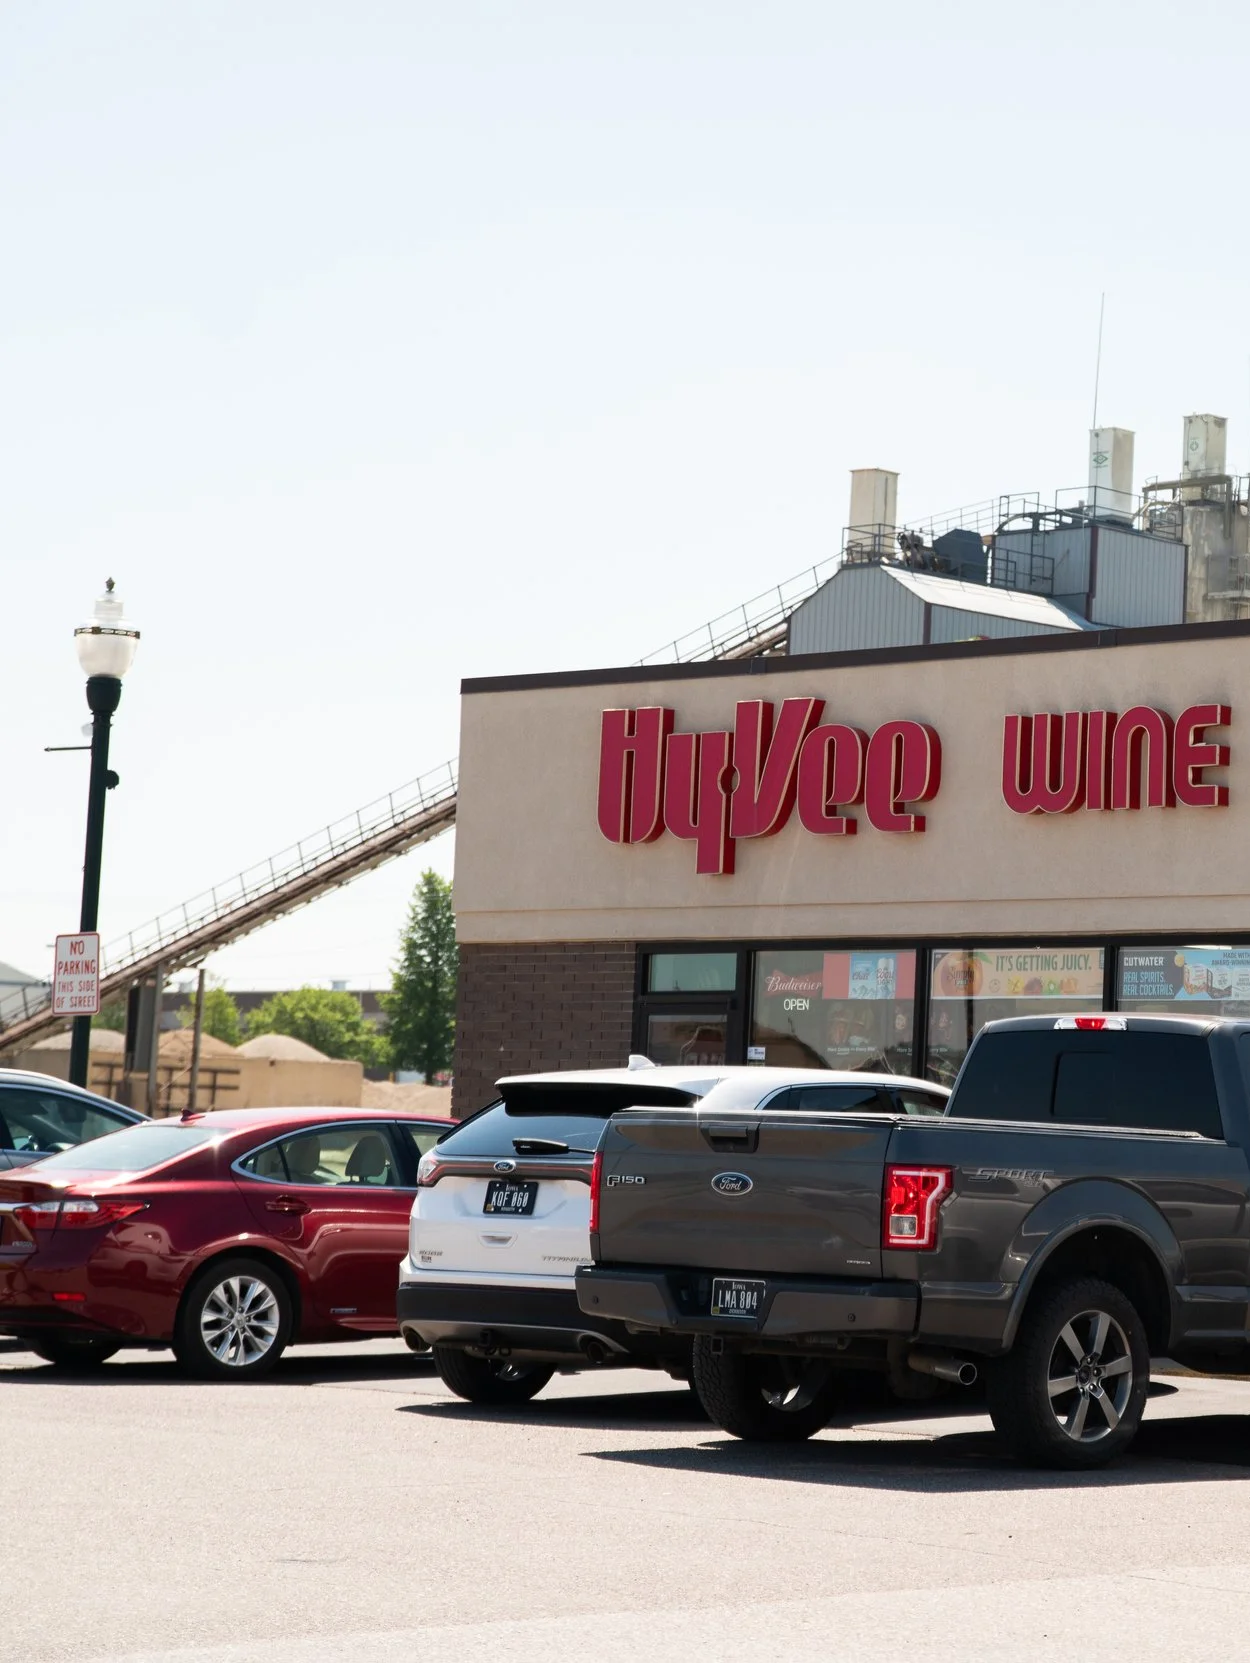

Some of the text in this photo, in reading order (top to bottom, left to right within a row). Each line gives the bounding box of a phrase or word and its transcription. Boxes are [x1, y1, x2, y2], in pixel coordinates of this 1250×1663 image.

[597, 696, 942, 874] HyVee
[1003, 704, 1232, 814] WINE
[70, 940, 85, 955] NO
[57, 960, 96, 975] PARKING
[996, 953, 1092, 972] IT'S GETTING JUICY.
[1123, 956, 1164, 967] CUTWATER
[765, 976, 822, 991] Budweiser
[1123, 972, 1139, 983] REAL
[57, 980, 95, 993] THIS SIDE
[1122, 984, 1139, 996] REAL
[56, 995, 95, 1008] OF STREET
[784, 998, 810, 1011] OPEN
[968, 1167, 1054, 1181] SPORT
[719, 1176, 742, 1190] Ford
[719, 1290, 757, 1309] LMA 804
